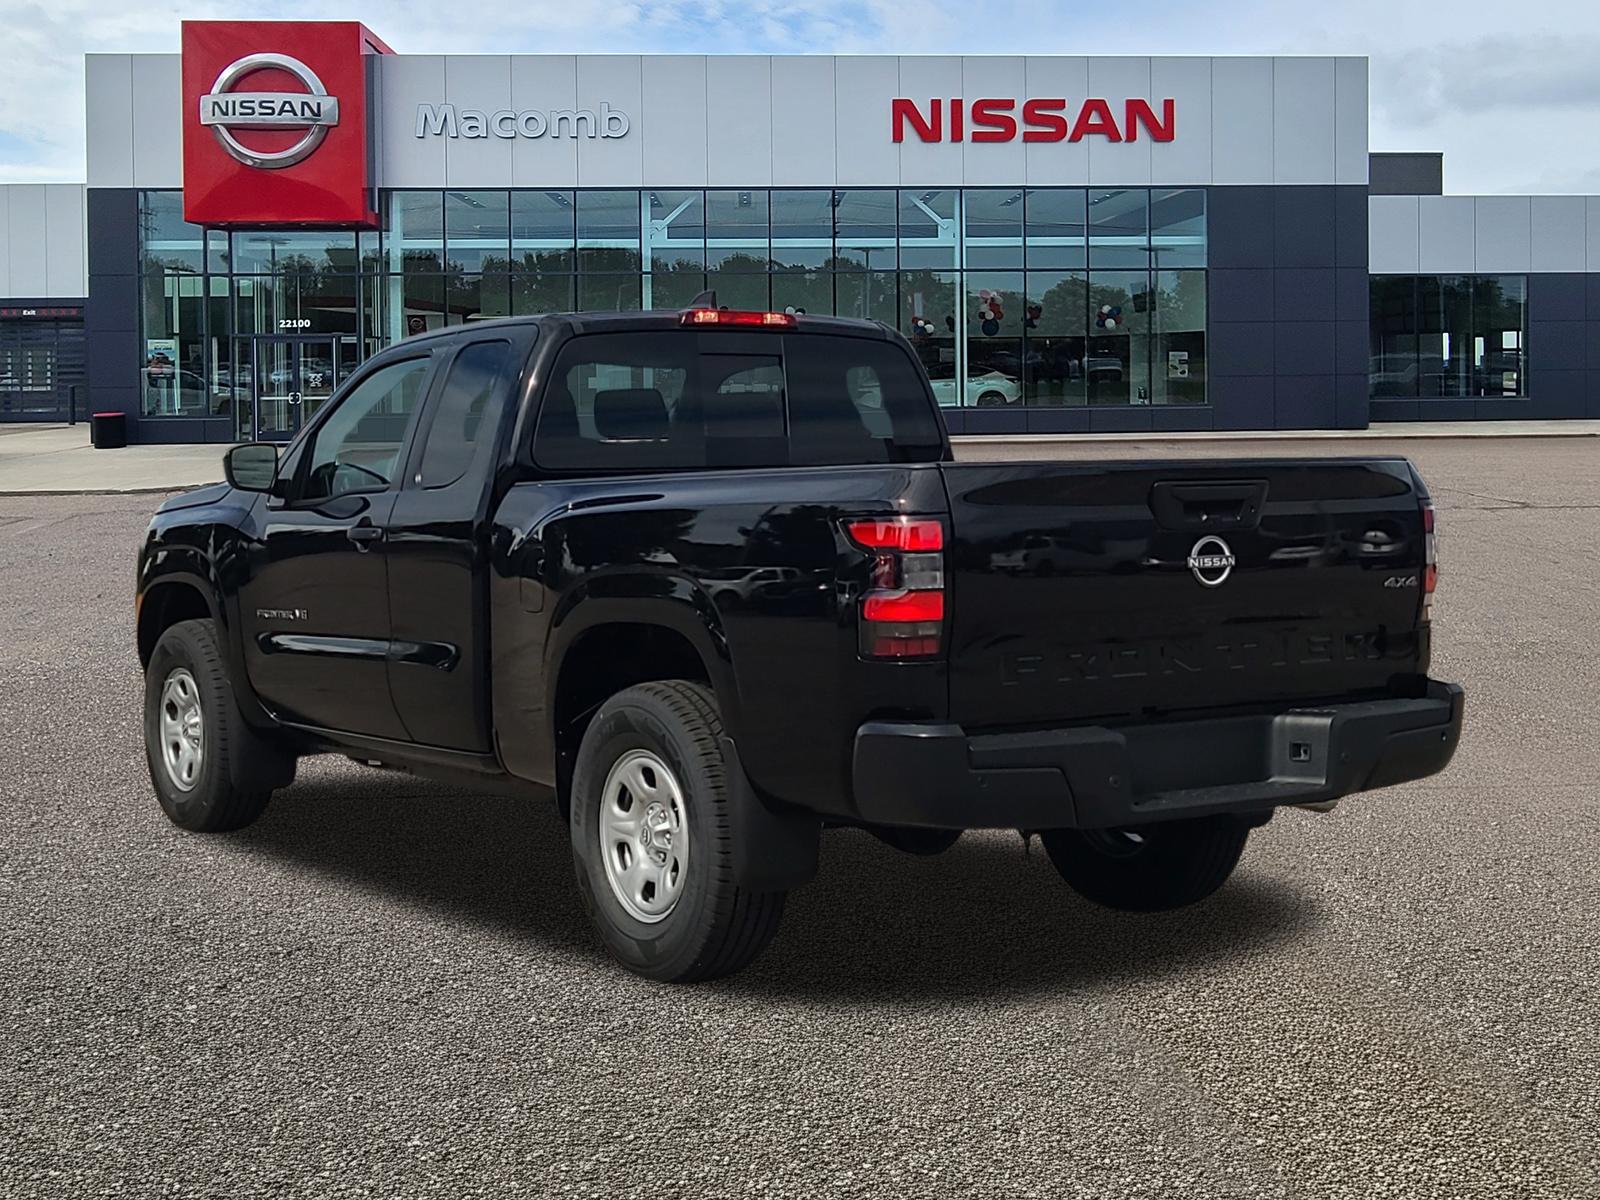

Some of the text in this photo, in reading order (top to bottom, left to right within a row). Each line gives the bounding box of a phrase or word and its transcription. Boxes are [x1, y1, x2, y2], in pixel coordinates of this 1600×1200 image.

[211, 98, 322, 119] NISSAN
[415, 102, 630, 139] Macomb
[892, 98, 1175, 142] NISSAN
[279, 319, 311, 329] 22100
[1188, 555, 1235, 568] NISSAN
[1001, 630, 1380, 686] FRONTIER
